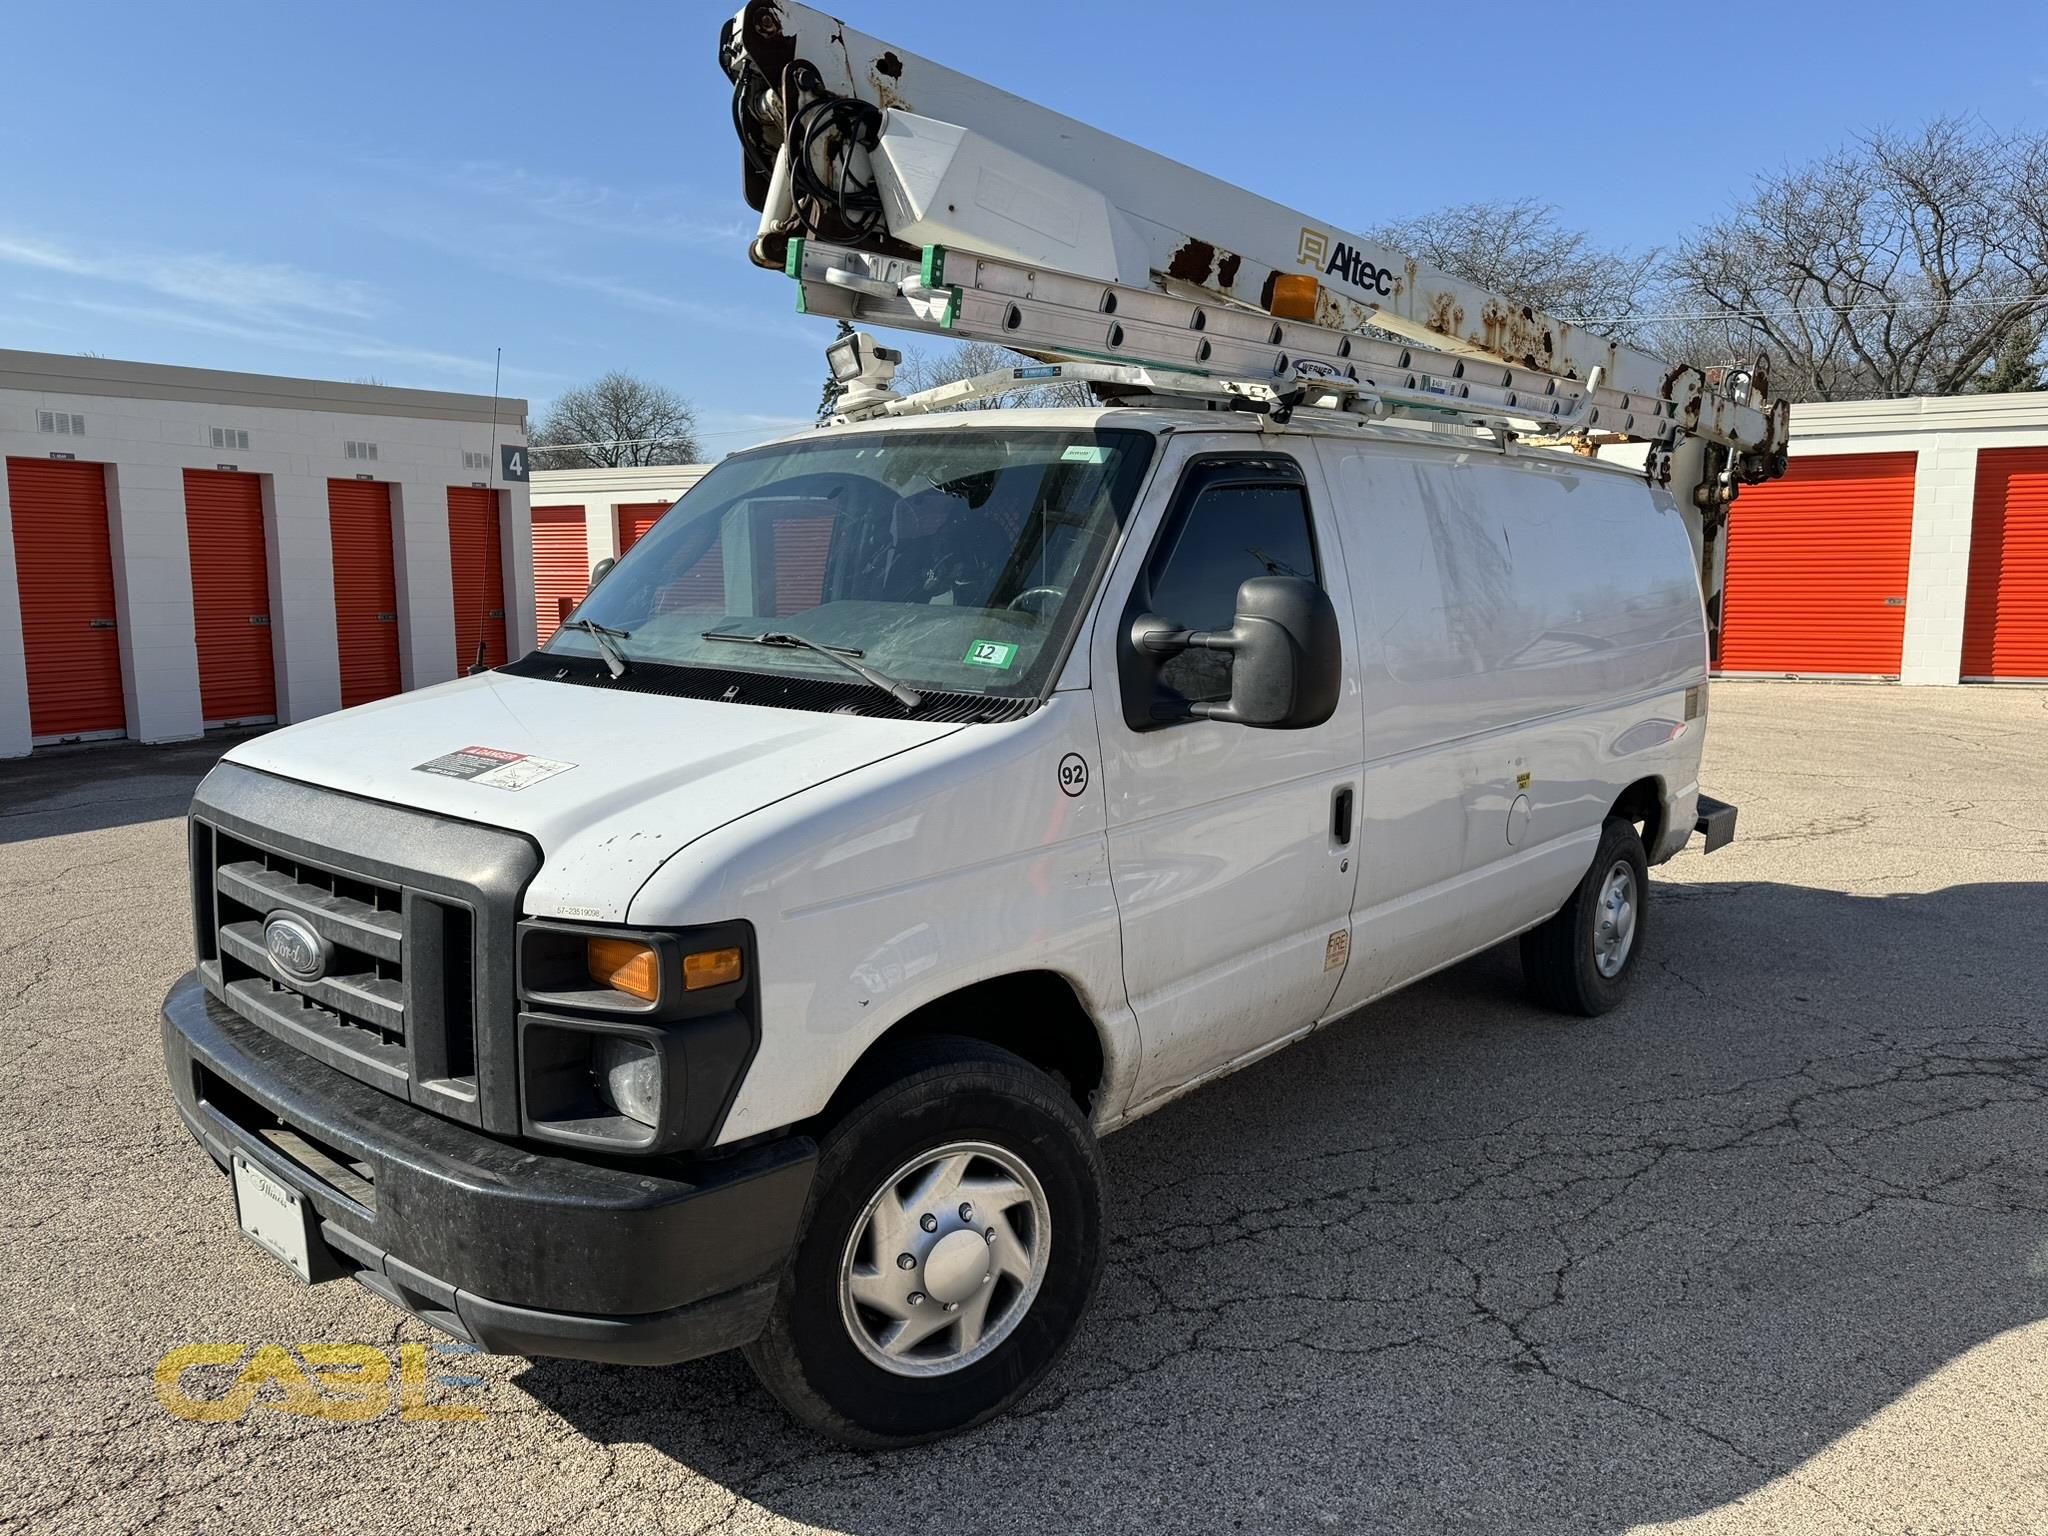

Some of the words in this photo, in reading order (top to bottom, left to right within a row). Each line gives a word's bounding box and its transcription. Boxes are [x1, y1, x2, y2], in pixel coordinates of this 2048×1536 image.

[1325, 242, 1393, 296] Altec
[1302, 362, 1333, 375] WERNER
[509, 452, 523, 476] 4
[974, 644, 996, 660] 12
[477, 748, 518, 760] DANGER
[1062, 765, 1084, 785] 92
[271, 929, 301, 963] Ford
[1328, 933, 1346, 953] FIRE
